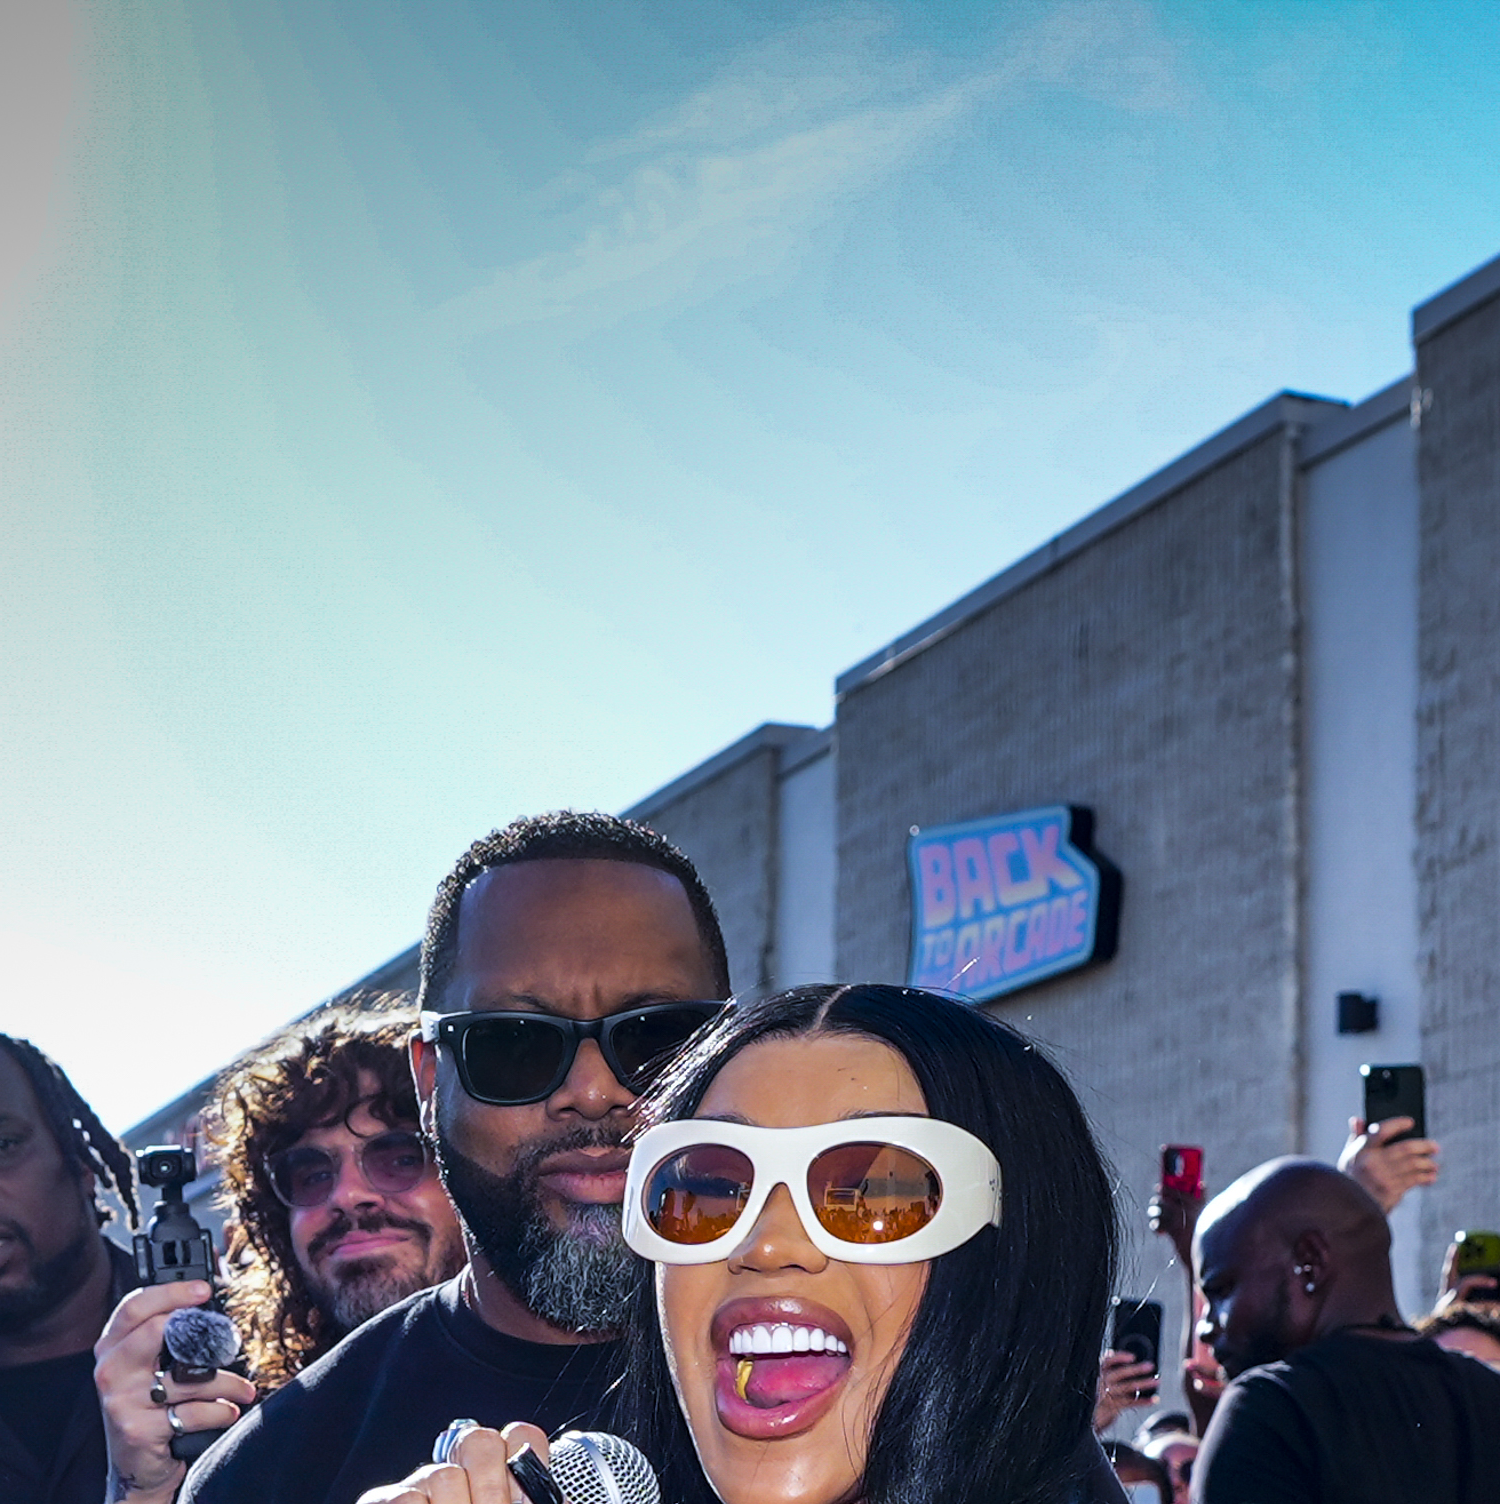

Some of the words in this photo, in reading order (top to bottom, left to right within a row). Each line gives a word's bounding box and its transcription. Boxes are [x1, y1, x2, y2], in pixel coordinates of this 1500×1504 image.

[919, 825, 1083, 929] BACK
[923, 929, 953, 969] TO
[951, 889, 1088, 993] ARCADE
